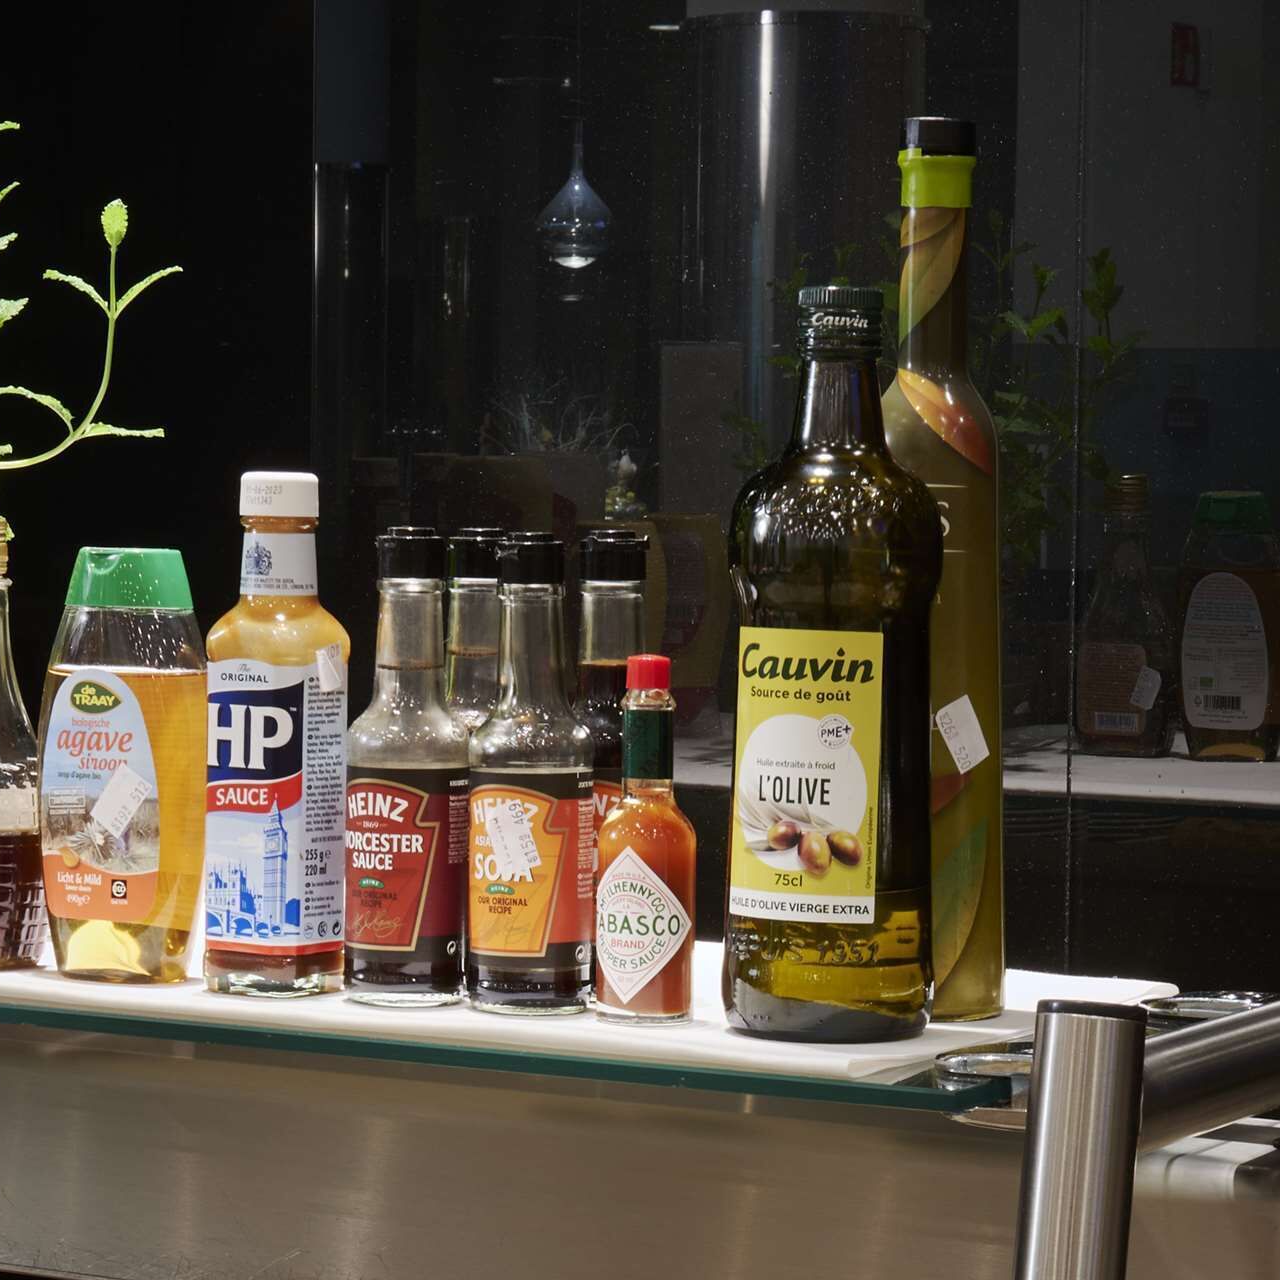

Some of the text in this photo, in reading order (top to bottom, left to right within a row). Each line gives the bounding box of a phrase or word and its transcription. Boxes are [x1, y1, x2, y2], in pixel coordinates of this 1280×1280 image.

[811, 312, 868, 328] Cauvin
[742, 642, 874, 684] Cauvin
[220, 672, 269, 684] ORIGINAL
[81, 684, 96, 695] de
[751, 686, 852, 703] Source de goût
[74, 694, 115, 706] TRAAY
[72, 718, 110, 729] biologische
[208, 702, 294, 770] HP
[821, 724, 852, 738] PME+
[57, 729, 133, 758] agave
[756, 757, 836, 770] Huile extraite à froid
[71, 770, 91, 780] d'agave
[216, 788, 268, 806] SAUCE
[759, 774, 830, 806] L'OLIVE
[348, 792, 408, 822] HEINZ
[306, 849, 318, 860] 255
[352, 852, 394, 870] SAUCE
[306, 862, 327, 876] 220 ml
[75, 874, 82, 884] &
[84, 874, 102, 886] Mild
[774, 873, 803, 887] 75cl
[490, 886, 509, 894] HEINZ
[478, 896, 528, 906] OUR ORIGINAL
[732, 896, 870, 914] HUILE D'OLIVE VIERGE EXTRA
[488, 905, 512, 915] RECIPE
[598, 912, 680, 937] ABASCO
[611, 939, 645, 950] BRAND
[630, 938, 666, 969] SAUCE
[818, 940, 880, 964] 1951
